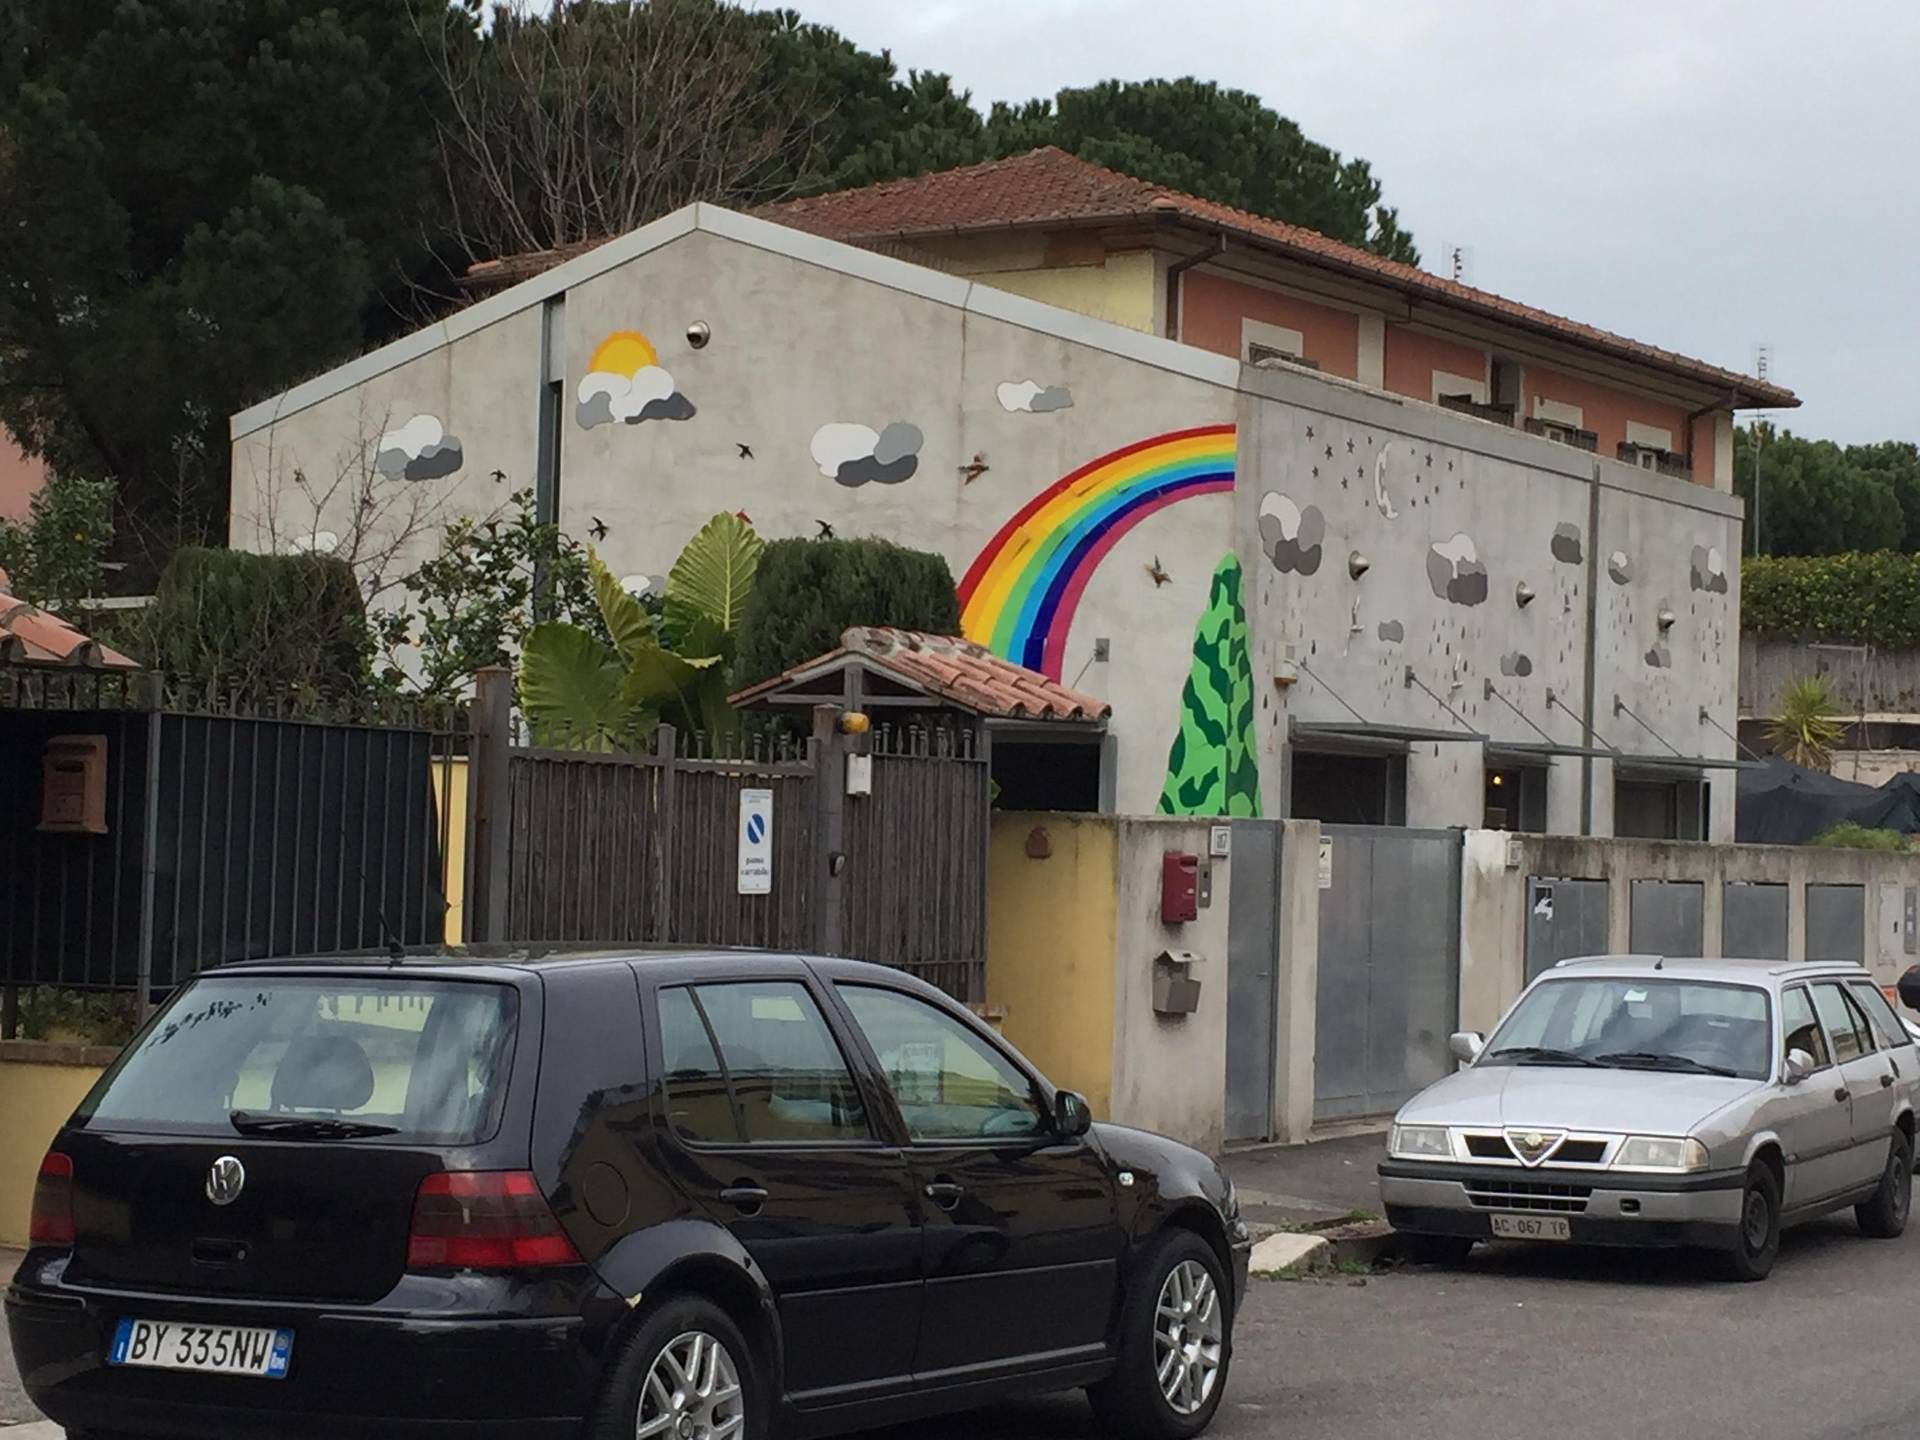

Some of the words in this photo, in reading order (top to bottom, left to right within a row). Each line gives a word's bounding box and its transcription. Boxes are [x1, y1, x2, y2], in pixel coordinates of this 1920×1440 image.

[1494, 1218, 1510, 1233] AC
[1517, 1220, 1542, 1234] 067
[131, 1323, 169, 1361] BY
[175, 1327, 270, 1369] 335NW
